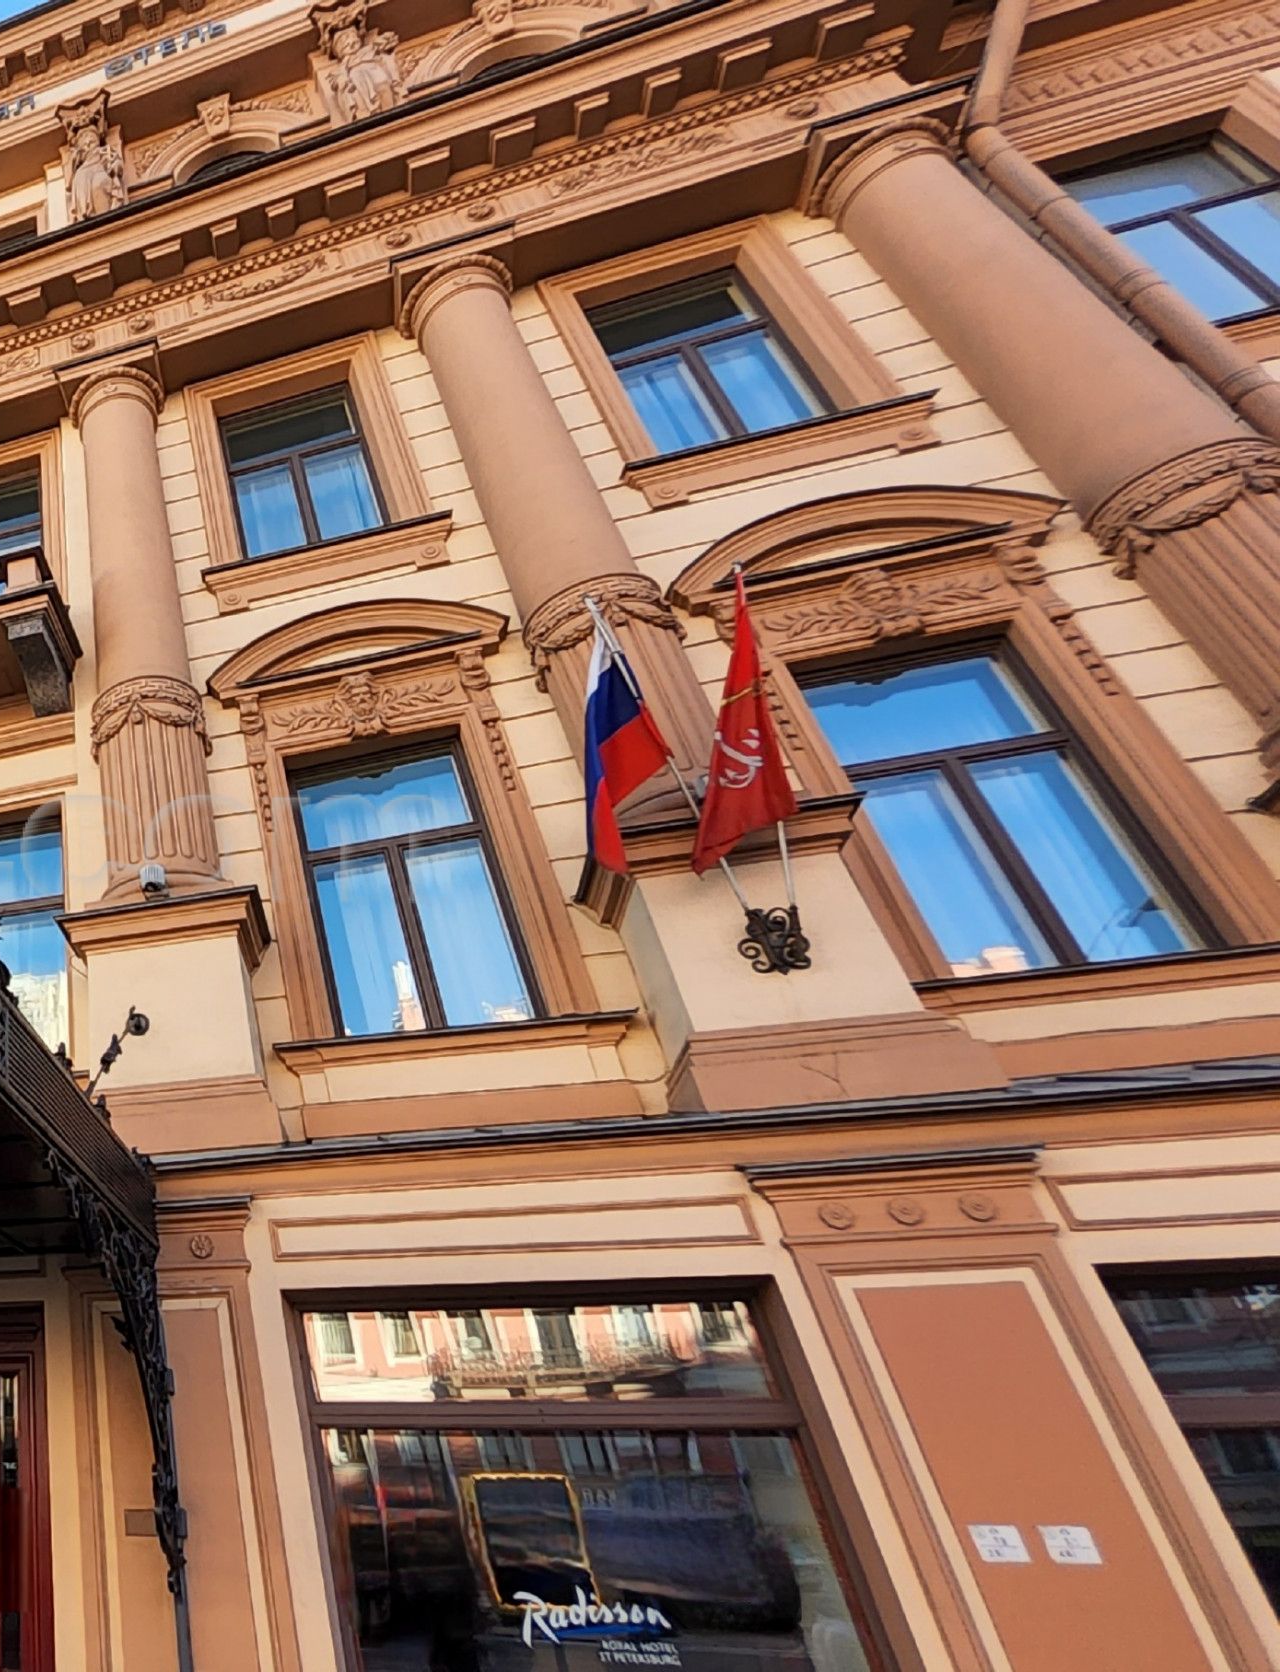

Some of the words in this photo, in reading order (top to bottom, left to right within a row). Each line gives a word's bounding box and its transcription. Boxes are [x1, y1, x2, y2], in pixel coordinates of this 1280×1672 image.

[104, 21, 227, 80] ОТЕЛЬ
[513, 1585, 672, 1649] Radisson
[613, 1652, 682, 1667] PETERSBURG
[640, 1641, 679, 1654] HOTEL
